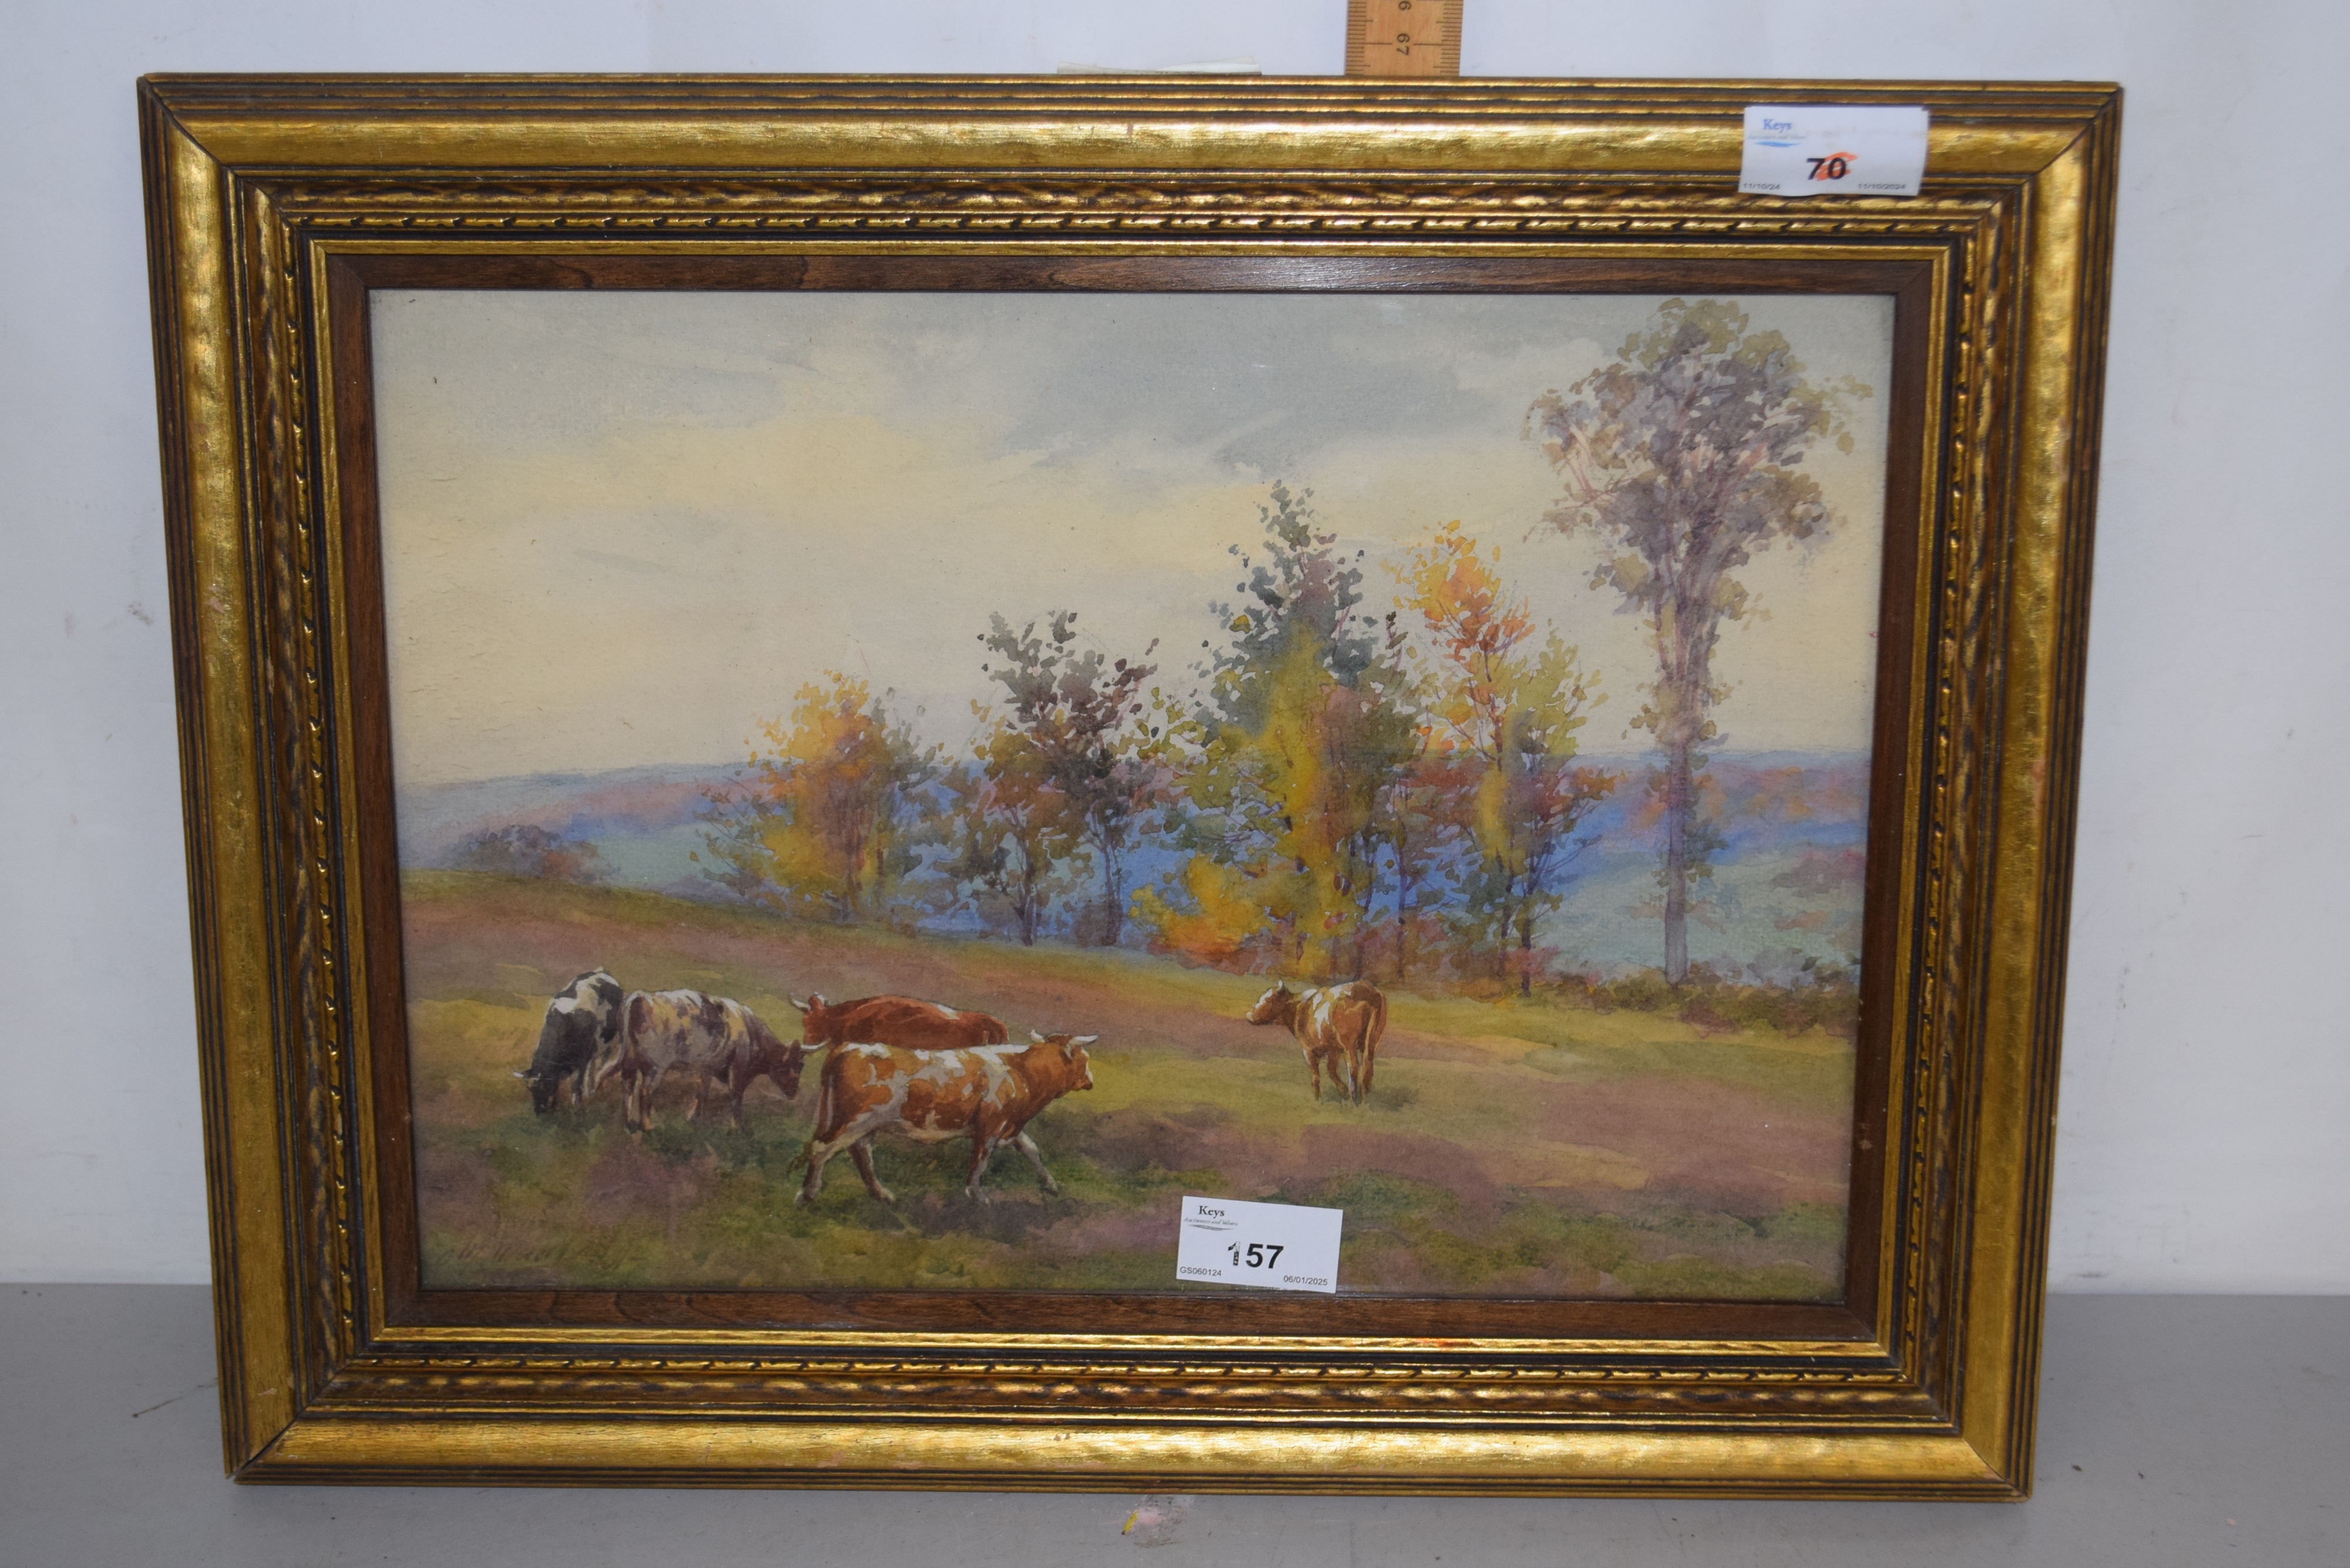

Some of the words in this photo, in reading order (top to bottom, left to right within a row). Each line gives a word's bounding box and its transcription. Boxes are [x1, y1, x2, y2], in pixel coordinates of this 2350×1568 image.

[1396, 33, 1410, 56] 67
[1762, 119, 1792, 133] Keys
[1806, 157, 1847, 180] 70
[1198, 1205, 1225, 1219] Keys
[1228, 1241, 1284, 1269] 157
[1180, 1267, 1222, 1277] GS060124
[1283, 1275, 1328, 1285] 06/01/2025
